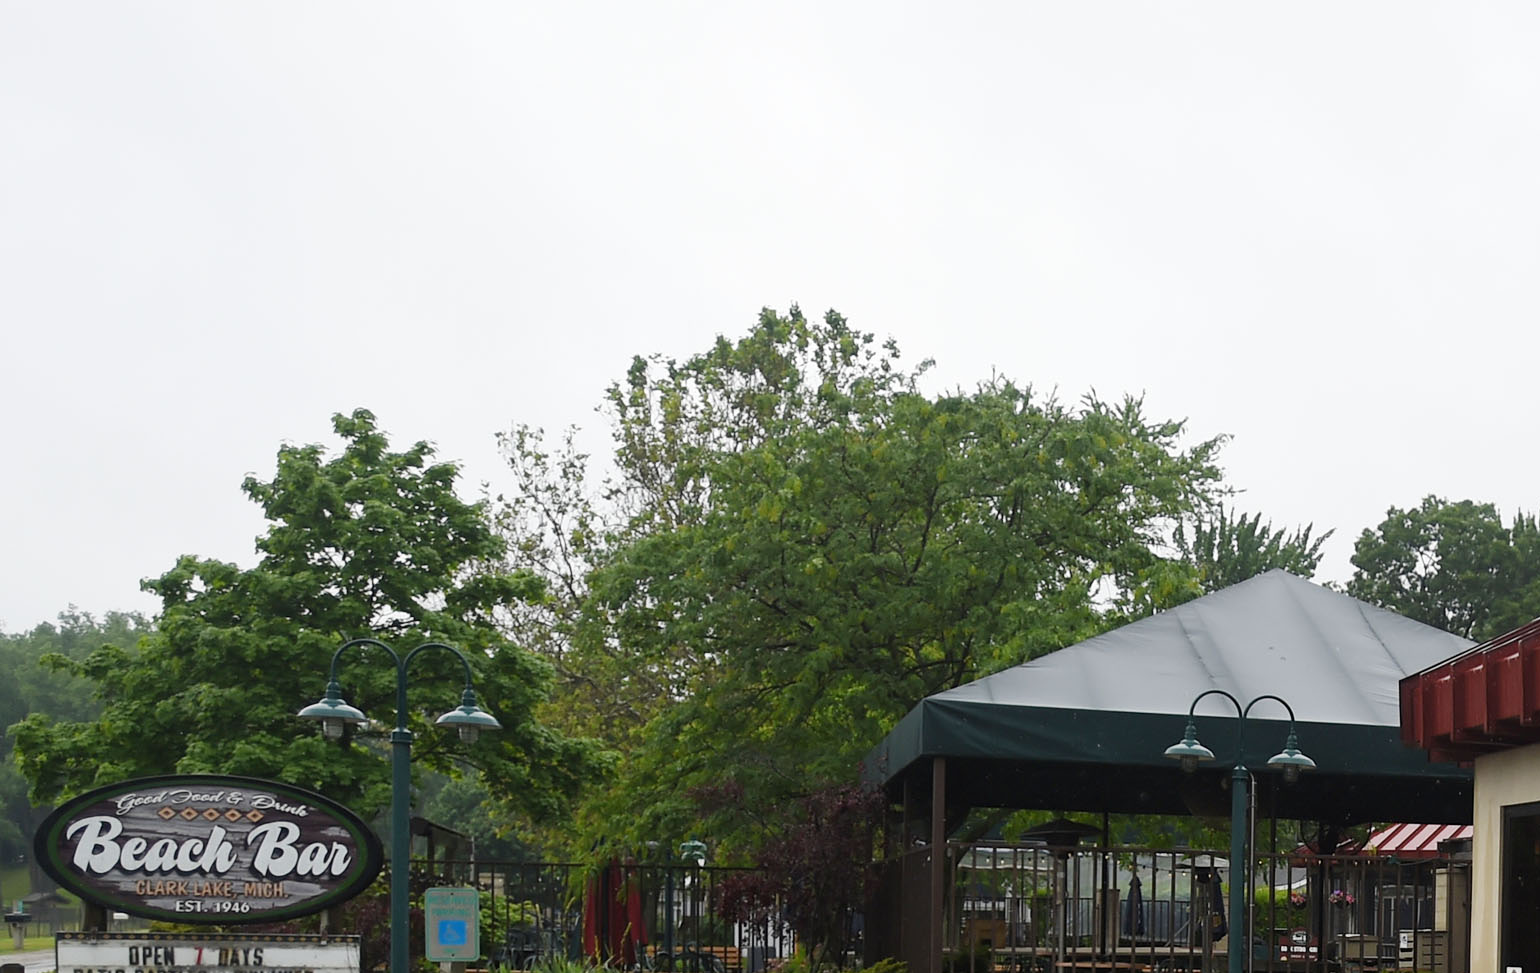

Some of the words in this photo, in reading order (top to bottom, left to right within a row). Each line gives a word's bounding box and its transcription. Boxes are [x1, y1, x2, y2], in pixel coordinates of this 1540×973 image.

[116, 791, 167, 815] Good
[169, 790, 226, 804] Food
[227, 791, 244, 804] &
[250, 795, 309, 817] Drink
[66, 815, 237, 874] Beach
[248, 821, 352, 877] Bar
[136, 880, 188, 896] CLARK
[193, 881, 237, 899] LAKE,
[244, 882, 289, 898] MICH.
[175, 900, 208, 913] EST.
[215, 901, 250, 913] 1946
[128, 946, 175, 966] OPEN
[194, 946, 204, 965] 7
[218, 947, 264, 966] DAYS
